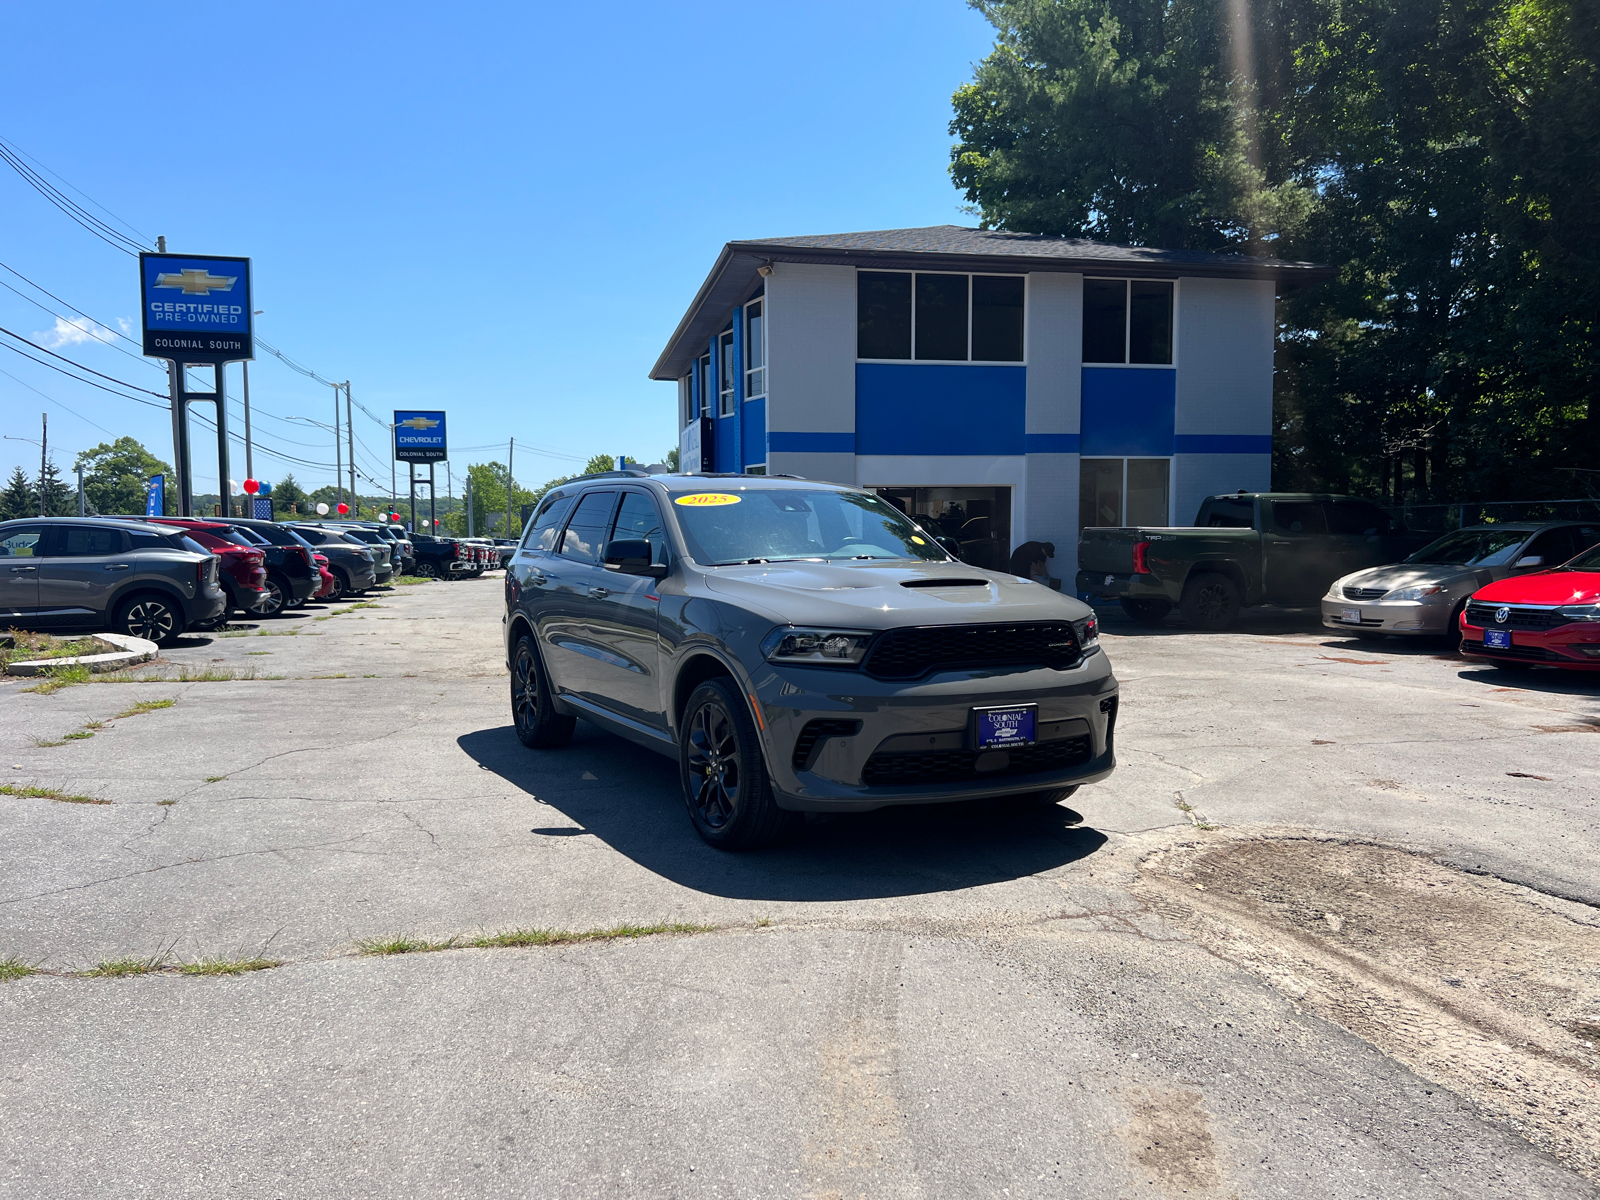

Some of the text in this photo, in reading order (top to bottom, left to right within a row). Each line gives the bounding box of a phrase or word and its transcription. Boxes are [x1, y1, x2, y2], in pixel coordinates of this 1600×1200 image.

[151, 302, 242, 314] CERTIFIED
[156, 312, 238, 324] PRE-OWNED
[155, 338, 241, 350] COLONIAL SOUTH
[687, 495, 728, 505] 2025
[988, 713, 1023, 722] COLONIAL
[993, 720, 1018, 729] SOUTH
